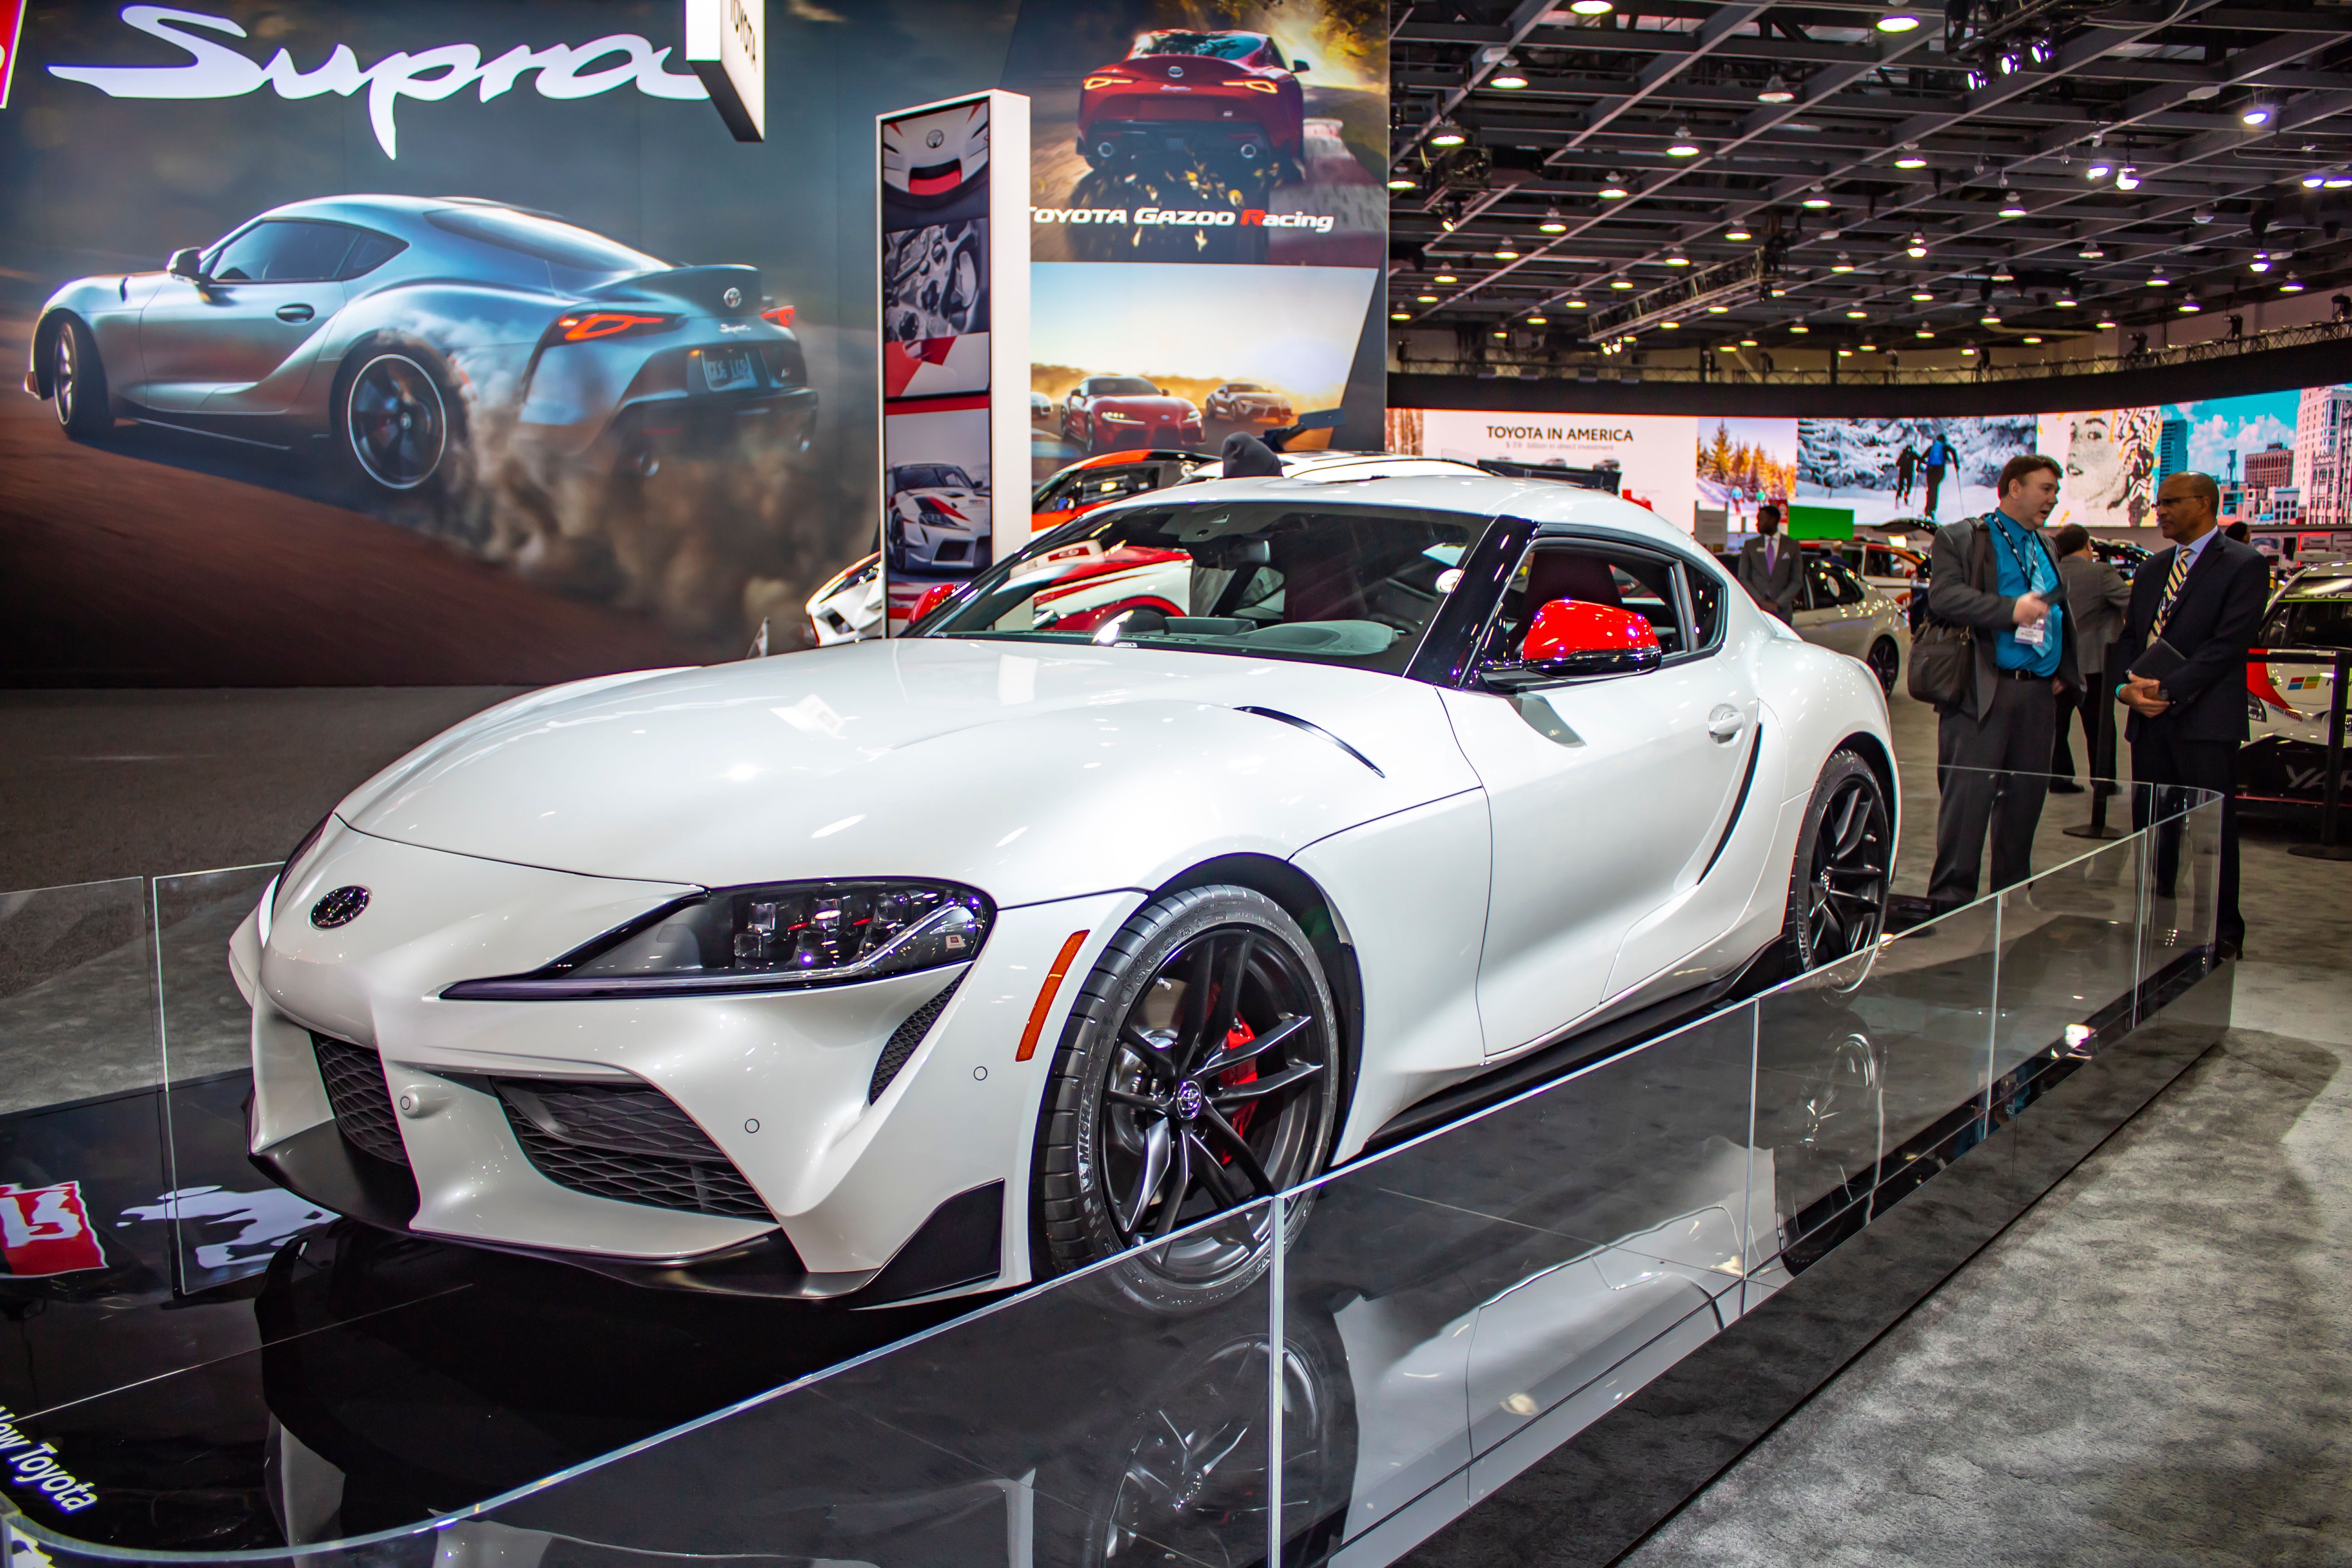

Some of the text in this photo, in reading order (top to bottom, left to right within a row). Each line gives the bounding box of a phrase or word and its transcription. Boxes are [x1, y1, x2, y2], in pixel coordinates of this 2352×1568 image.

[47, 4, 710, 160] Supra
[1133, 207, 1235, 225] GAZOO
[1240, 209, 1334, 233] Racing
[1487, 426, 1633, 441] TOYOTA IN AMERICA
[10, 1442, 97, 1511] Toyota
